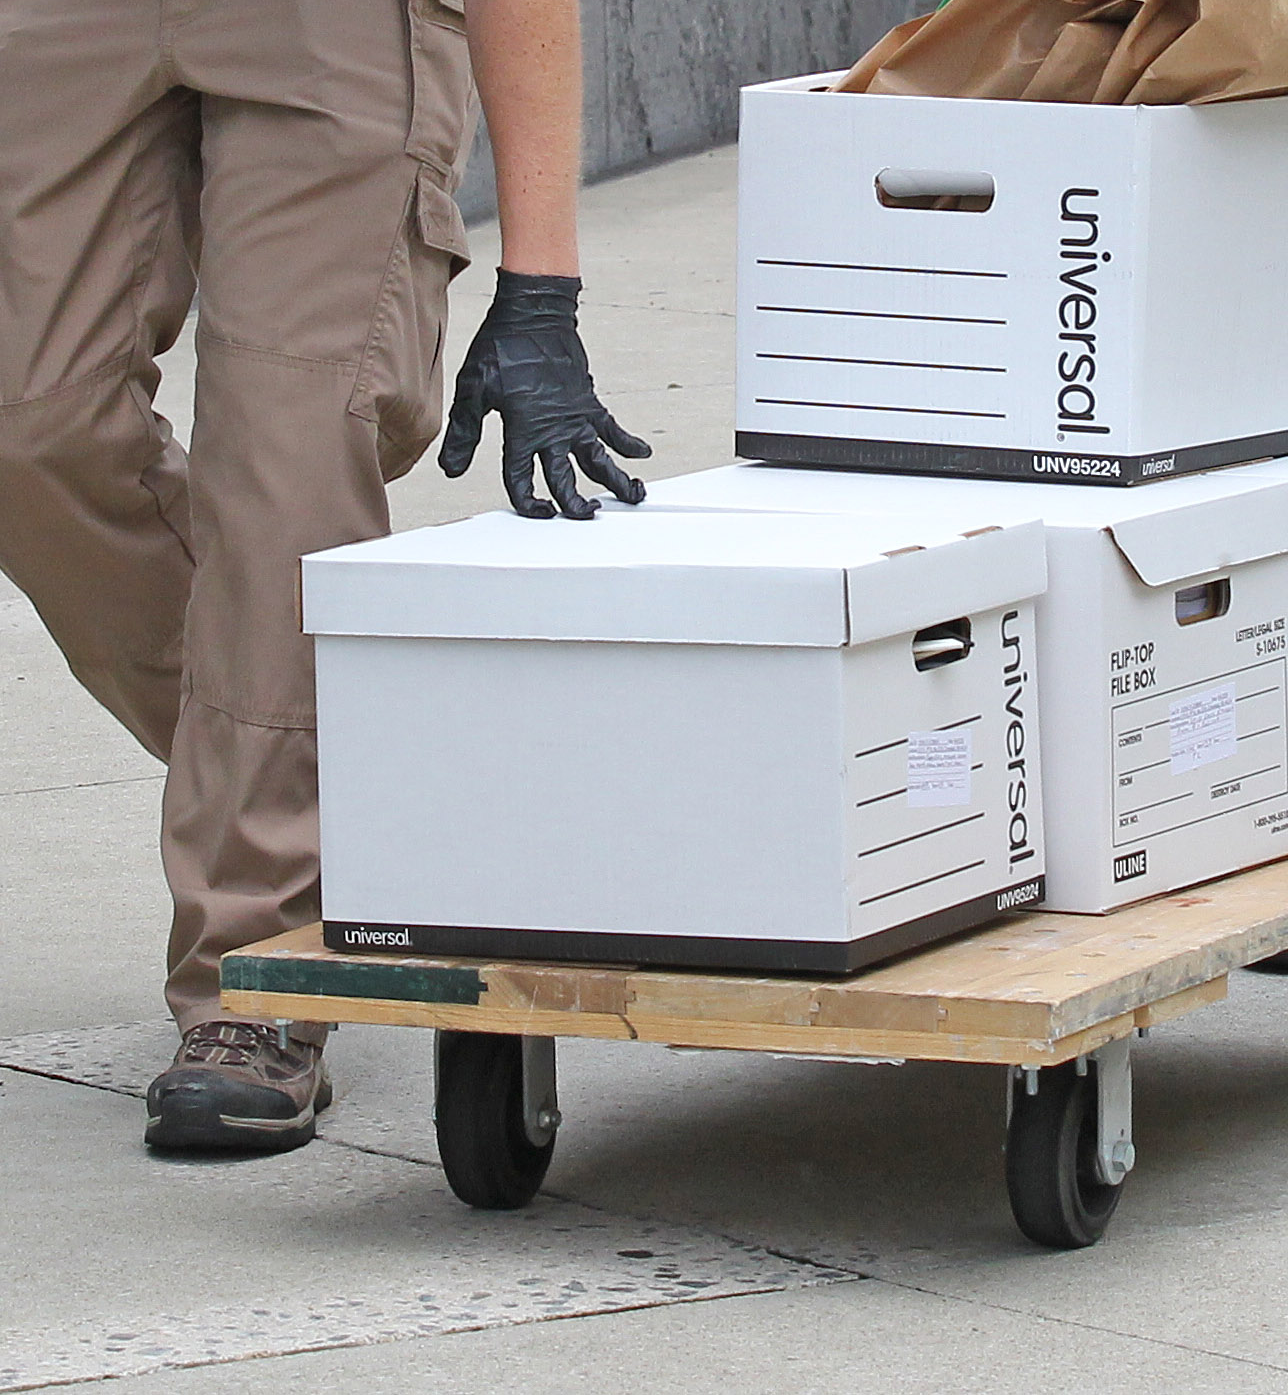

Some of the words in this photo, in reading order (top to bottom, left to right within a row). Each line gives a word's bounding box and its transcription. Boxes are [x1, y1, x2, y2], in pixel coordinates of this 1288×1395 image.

[1033, 454, 1121, 477] UNV95224
[1142, 454, 1175, 476] universal
[1111, 642, 1154, 672] FLIP-TOP
[1256, 635, 1286, 656] S-10675
[1111, 673, 1131, 697] FILE
[1134, 666, 1156, 691] BOX
[1001, 610, 1035, 864] universal
[1115, 854, 1145, 879] ULINE
[997, 881, 1039, 911] UNV95224
[345, 926, 410, 946] universal
